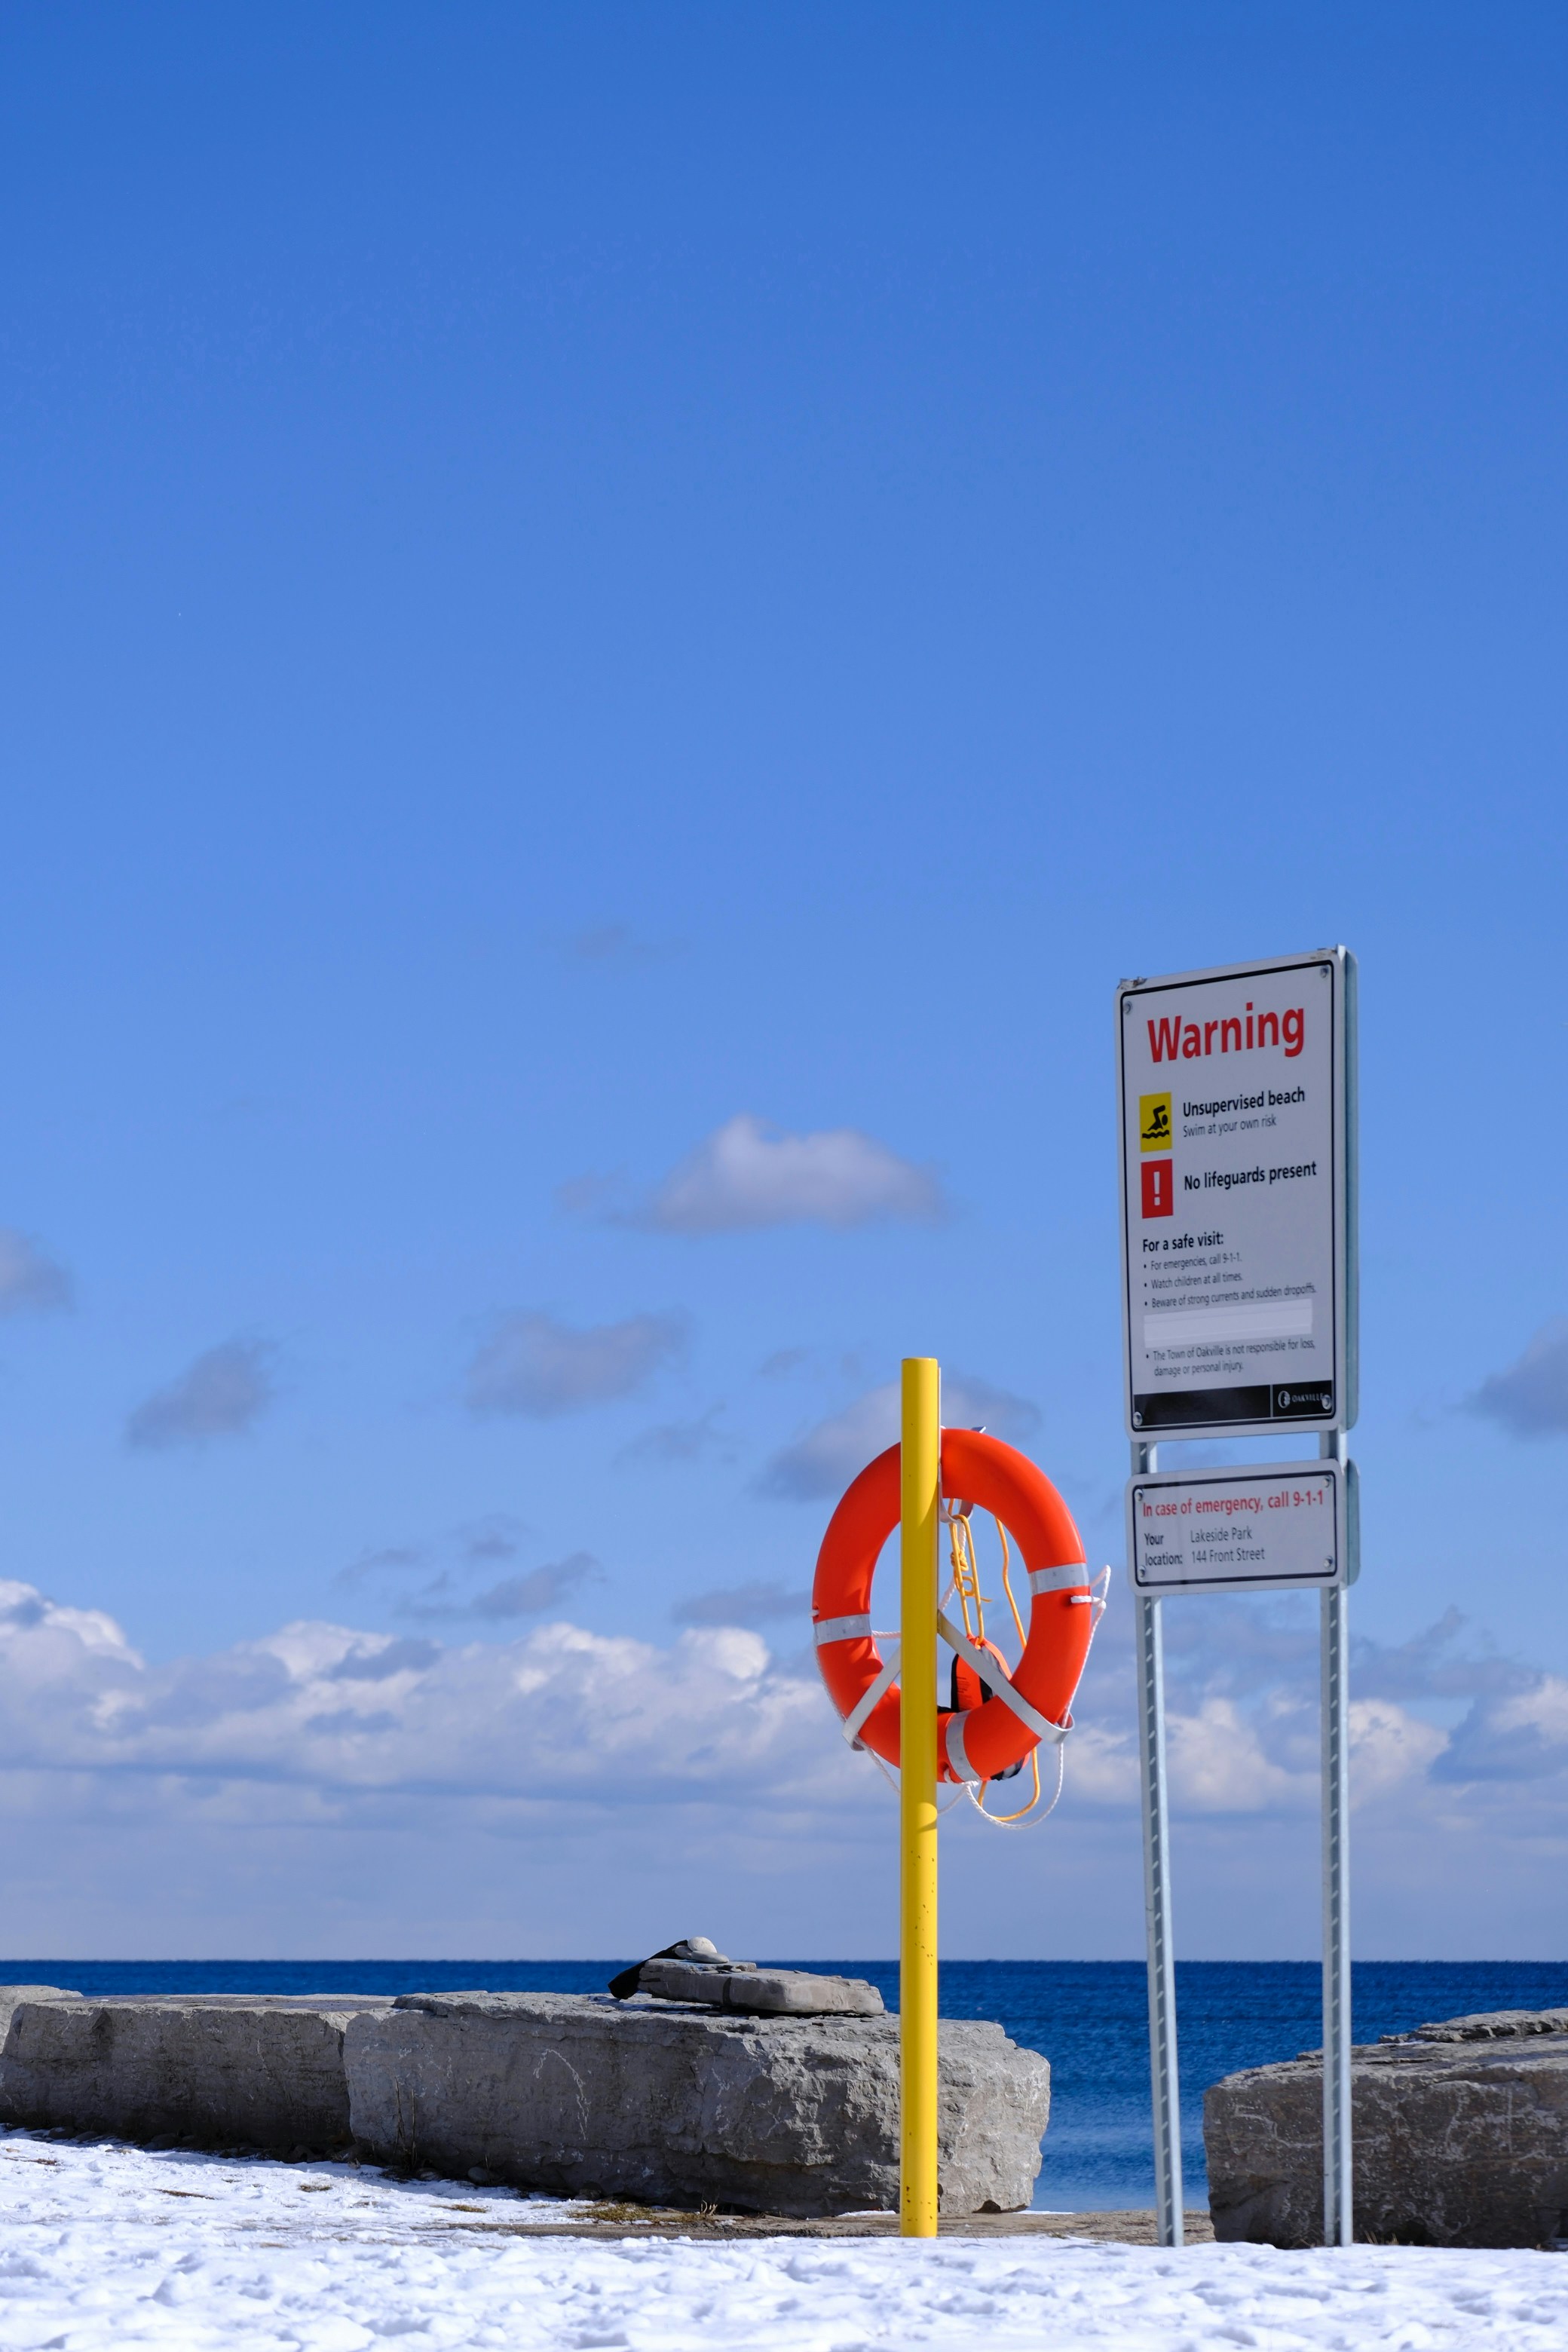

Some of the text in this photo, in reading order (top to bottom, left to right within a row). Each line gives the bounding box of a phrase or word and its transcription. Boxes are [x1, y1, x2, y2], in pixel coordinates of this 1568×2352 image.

[1147, 1002, 1304, 1063] Warning
[1183, 1086, 1305, 1117] Unsupervised beach
[1184, 1114, 1276, 1138] Swim at your own risk
[1184, 1161, 1317, 1190] No lifeguards present
[1142, 1231, 1223, 1252] For a safe visit:
[1150, 1252, 1242, 1270] For emergencies, call 9-1-1.
[1150, 1272, 1242, 1289] Watch children at all times.
[1152, 1298, 1176, 1308] Beware
[1178, 1294, 1186, 1306] of
[1187, 1294, 1209, 1306] strong
[1211, 1291, 1239, 1303] currents
[1241, 1288, 1254, 1299] and
[1256, 1286, 1282, 1298] sudden
[1153, 1338, 1315, 1361] The Town of Oakville is not responsible for loss,
[1154, 1360, 1244, 1377] damage or personal injury.
[1143, 1490, 1323, 1517] In case of emergency, call 9-1-1
[1144, 1533, 1164, 1546] Your
[1190, 1526, 1253, 1543] Lakeside Park
[1145, 1552, 1183, 1566] location:
[1192, 1548, 1265, 1563] 144 Front Street
